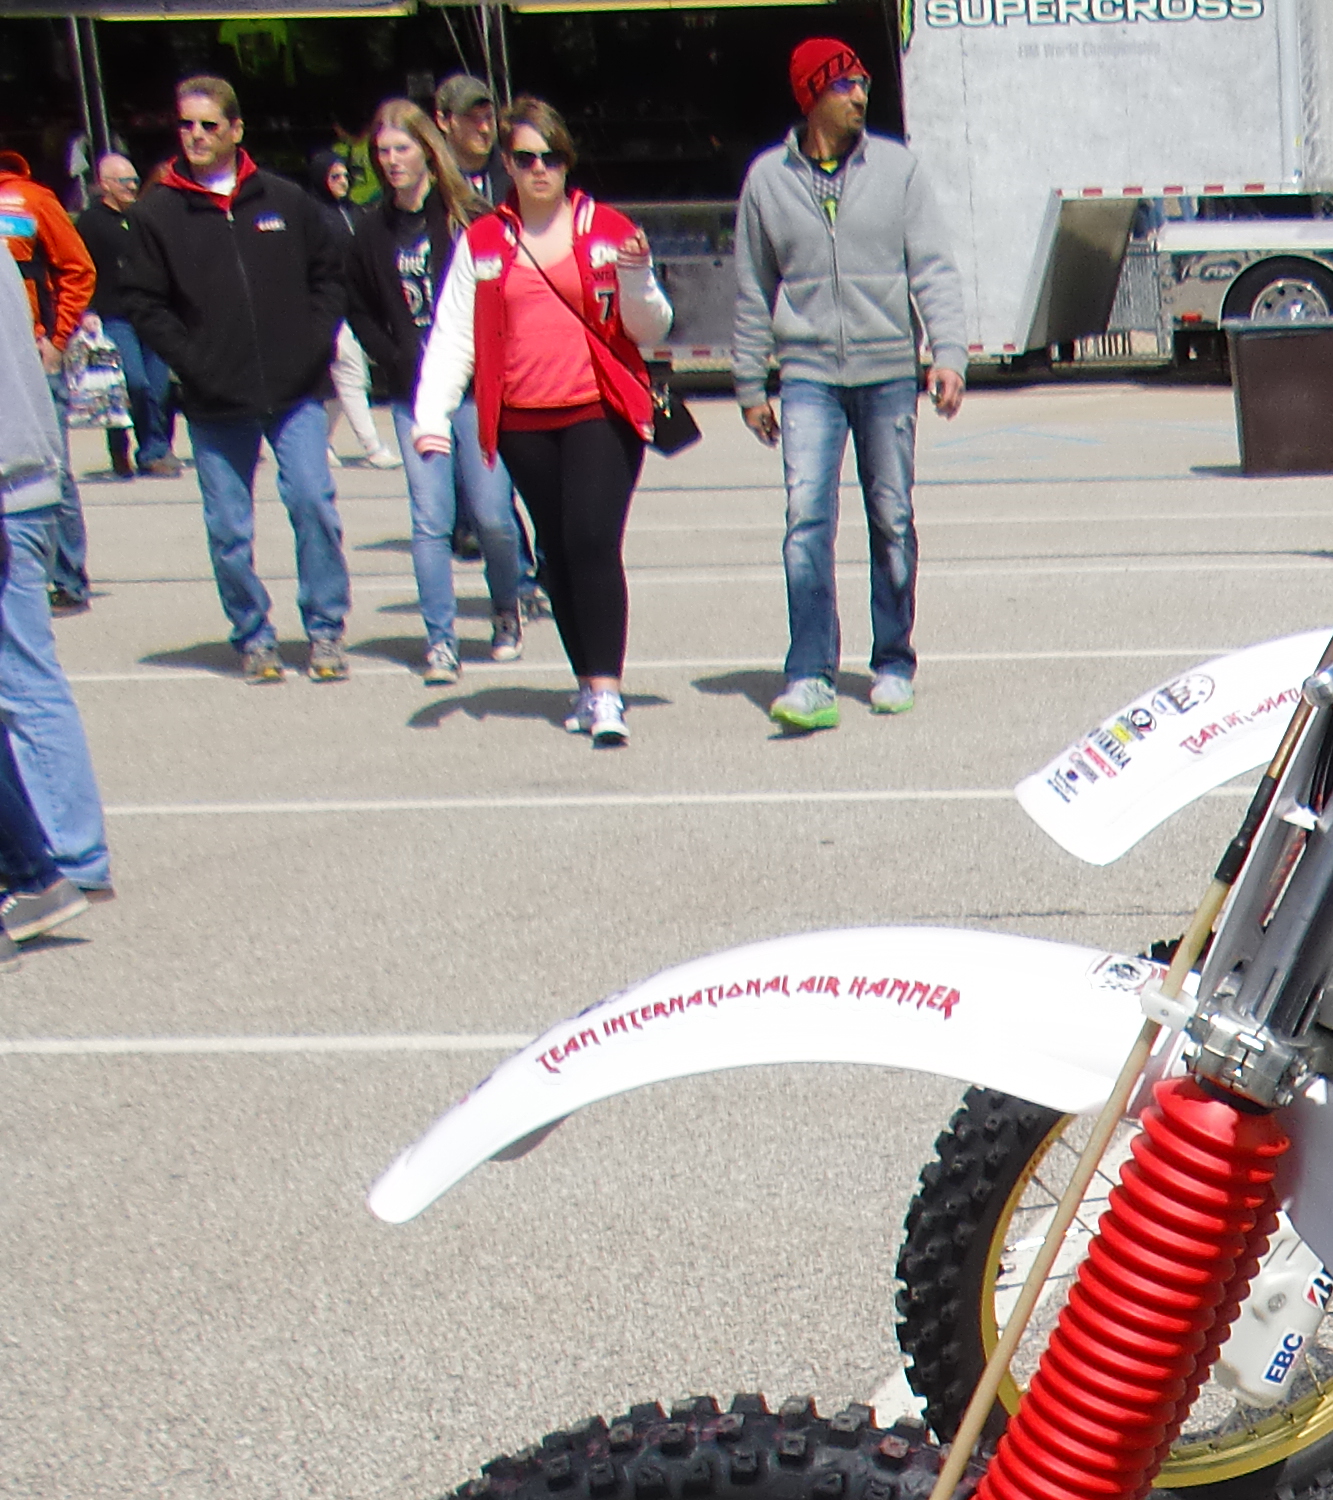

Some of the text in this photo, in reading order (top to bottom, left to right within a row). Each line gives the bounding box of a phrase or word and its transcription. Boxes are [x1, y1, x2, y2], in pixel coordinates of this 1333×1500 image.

[925, 0, 1265, 28] SUPERCROSS
[535, 974, 962, 1075] TEAM INTERNATIONAL AIR HAMMER
[1265, 1332, 1304, 1386] EBC
